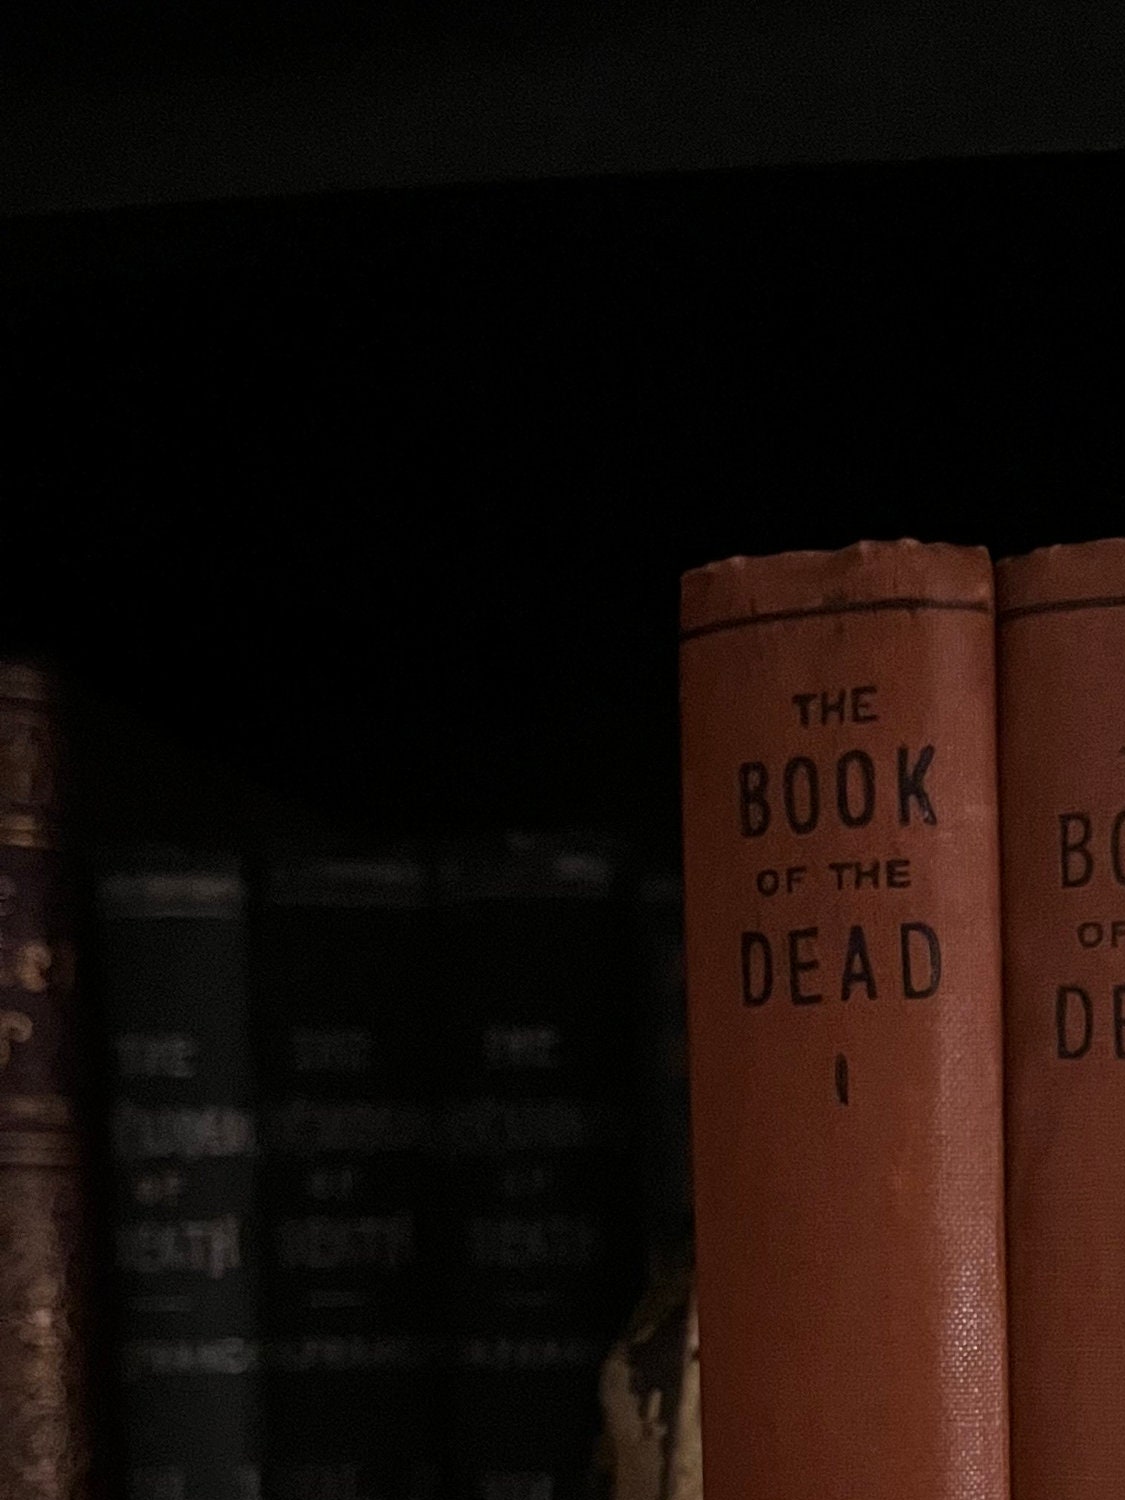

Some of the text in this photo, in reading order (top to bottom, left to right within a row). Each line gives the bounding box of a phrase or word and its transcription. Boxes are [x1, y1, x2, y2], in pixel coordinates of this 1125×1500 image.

[793, 686, 878, 727] THE
[739, 744, 938, 838] BOOK
[757, 858, 911, 897] OF THE
[740, 922, 942, 1007] DEAD
[833, 1052, 849, 1106] I
